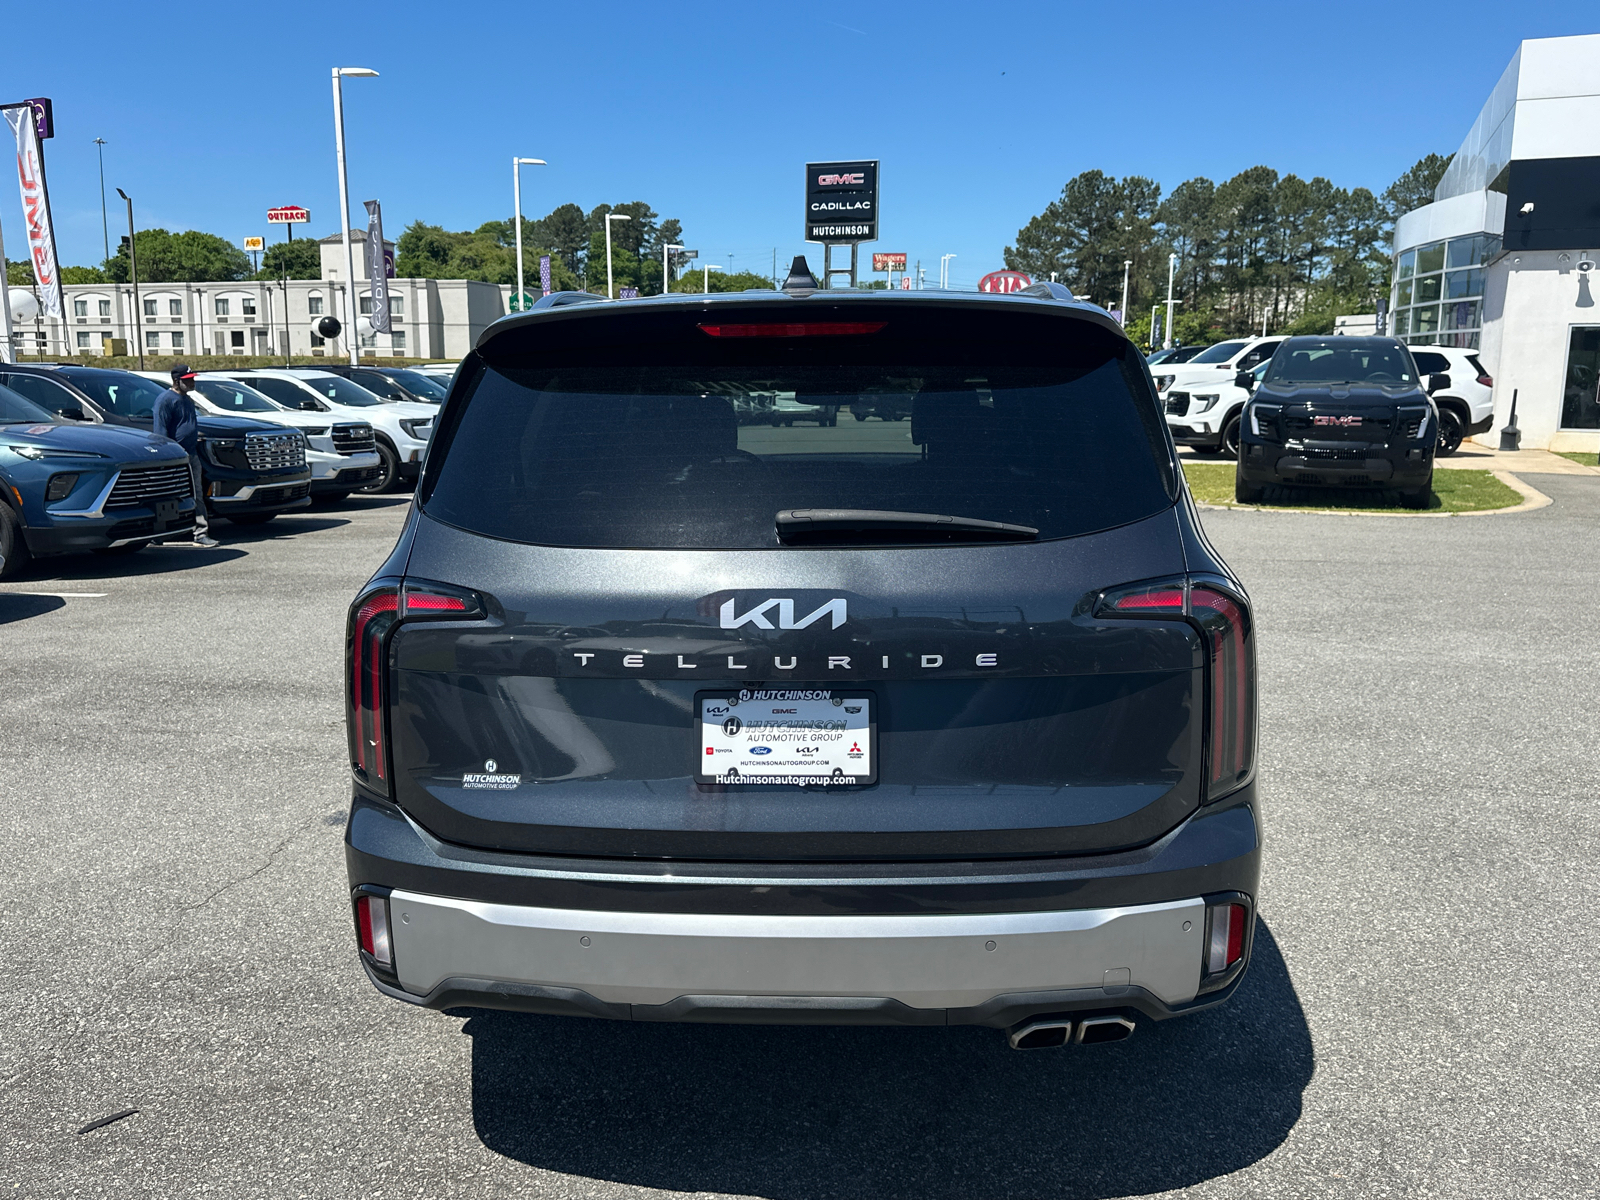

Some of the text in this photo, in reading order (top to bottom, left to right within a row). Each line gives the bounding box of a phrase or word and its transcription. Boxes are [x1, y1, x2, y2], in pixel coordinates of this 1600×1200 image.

[818, 173, 864, 185] GMC
[811, 201, 871, 211] CADILLAC
[267, 212, 306, 220] OUTBACK
[812, 225, 869, 236] HUTCHINSON
[990, 277, 1021, 293] KIA
[1314, 416, 1362, 426] GMC
[720, 598, 847, 630] KIA
[574, 652, 998, 669] TELLURIDE
[753, 690, 831, 700] HUTCHINSON
[745, 719, 848, 733] HUTCHINSON
[747, 733, 843, 742] AUTOMOTIVE GROUP
[753, 747, 768, 755] Ford
[463, 775, 520, 783] HUTCHINSON
[715, 774, 856, 786] Hutchinsonautogroup.com
